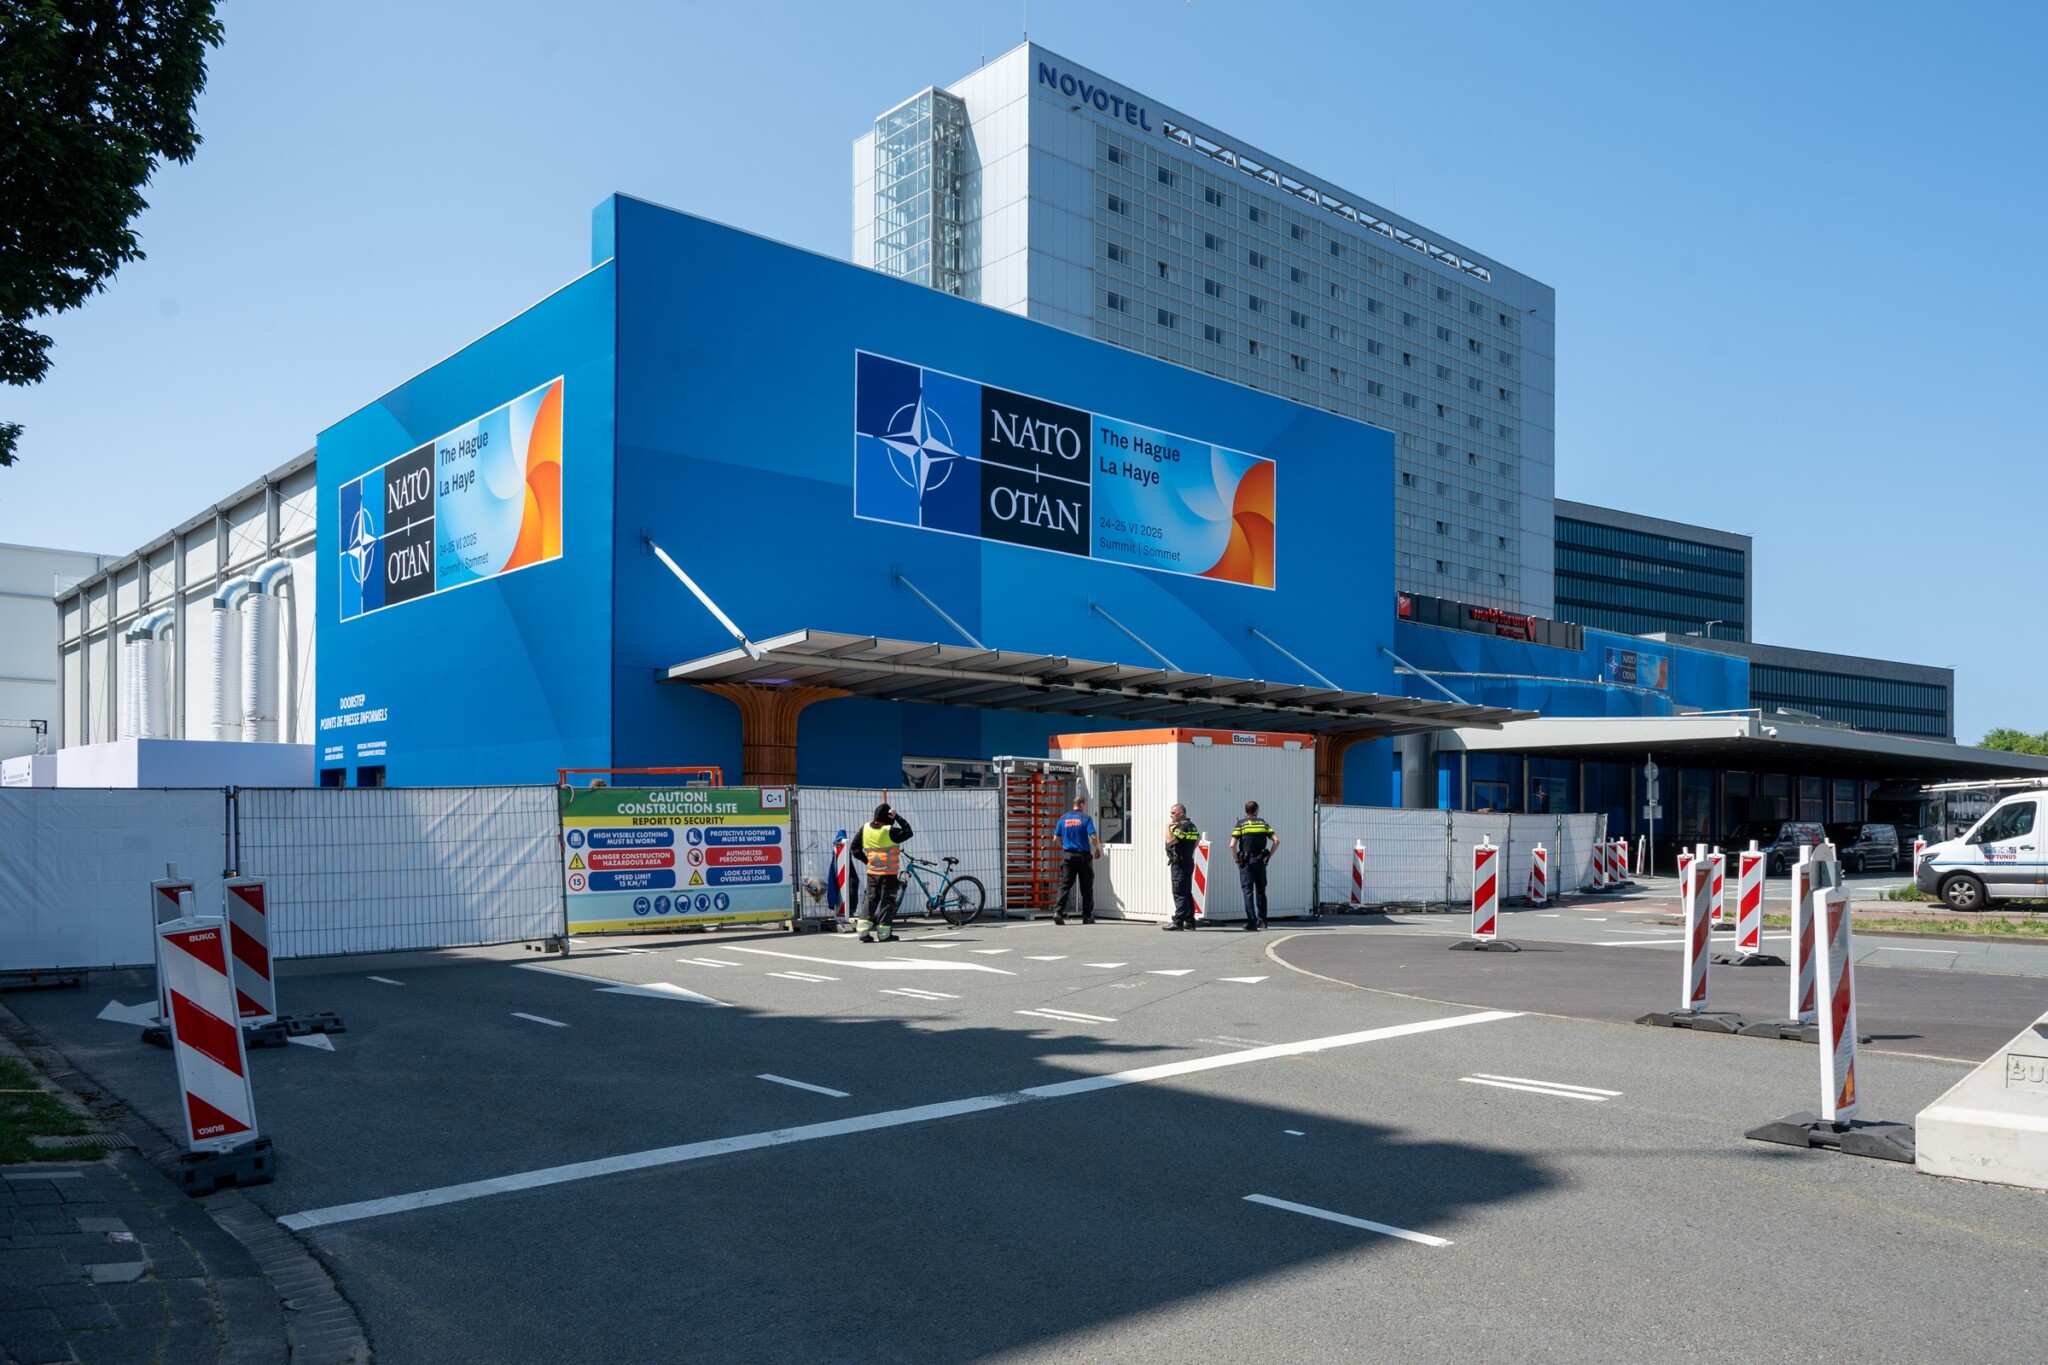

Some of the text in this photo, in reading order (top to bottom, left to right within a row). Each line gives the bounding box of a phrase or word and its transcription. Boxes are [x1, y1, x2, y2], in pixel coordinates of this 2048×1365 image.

[1039, 62, 1152, 132] NOVOTEL
[990, 409, 1081, 461] NATO
[440, 431, 489, 467] The Hague
[1100, 428, 1181, 464] The Hague
[1100, 456, 1160, 487] La Haye
[387, 467, 430, 514] NATO
[439, 468, 475, 497] La Haye
[990, 486, 1081, 535] OTAN
[1100, 517, 1163, 539] 24-25 VI 2025
[439, 533, 477, 556] 24-25 VI 2025
[1100, 537, 1181, 562] Summit Sommet
[388, 541, 430, 584] OTAN
[439, 552, 489, 578] Summit Sommet
[1622, 655, 1636, 664] NATO
[1622, 671, 1636, 680] OTAN
[340, 694, 366, 710] DOORSTEP
[320, 716, 337, 731] POINTS
[337, 715, 343, 728] DE
[1233, 735, 1255, 743] Boels
[649, 792, 708, 803] CAUTION!
[766, 794, 782, 803] C-1
[617, 803, 738, 814] CONSTRUCTION SITE
[632, 816, 725, 826] REPORT TO SECURITY
[621, 852, 671, 860] CONSTRUCTION
[573, 878, 582, 886] 15
[189, 932, 217, 943] BUKO.
[2010, 1065, 2048, 1084] BU
